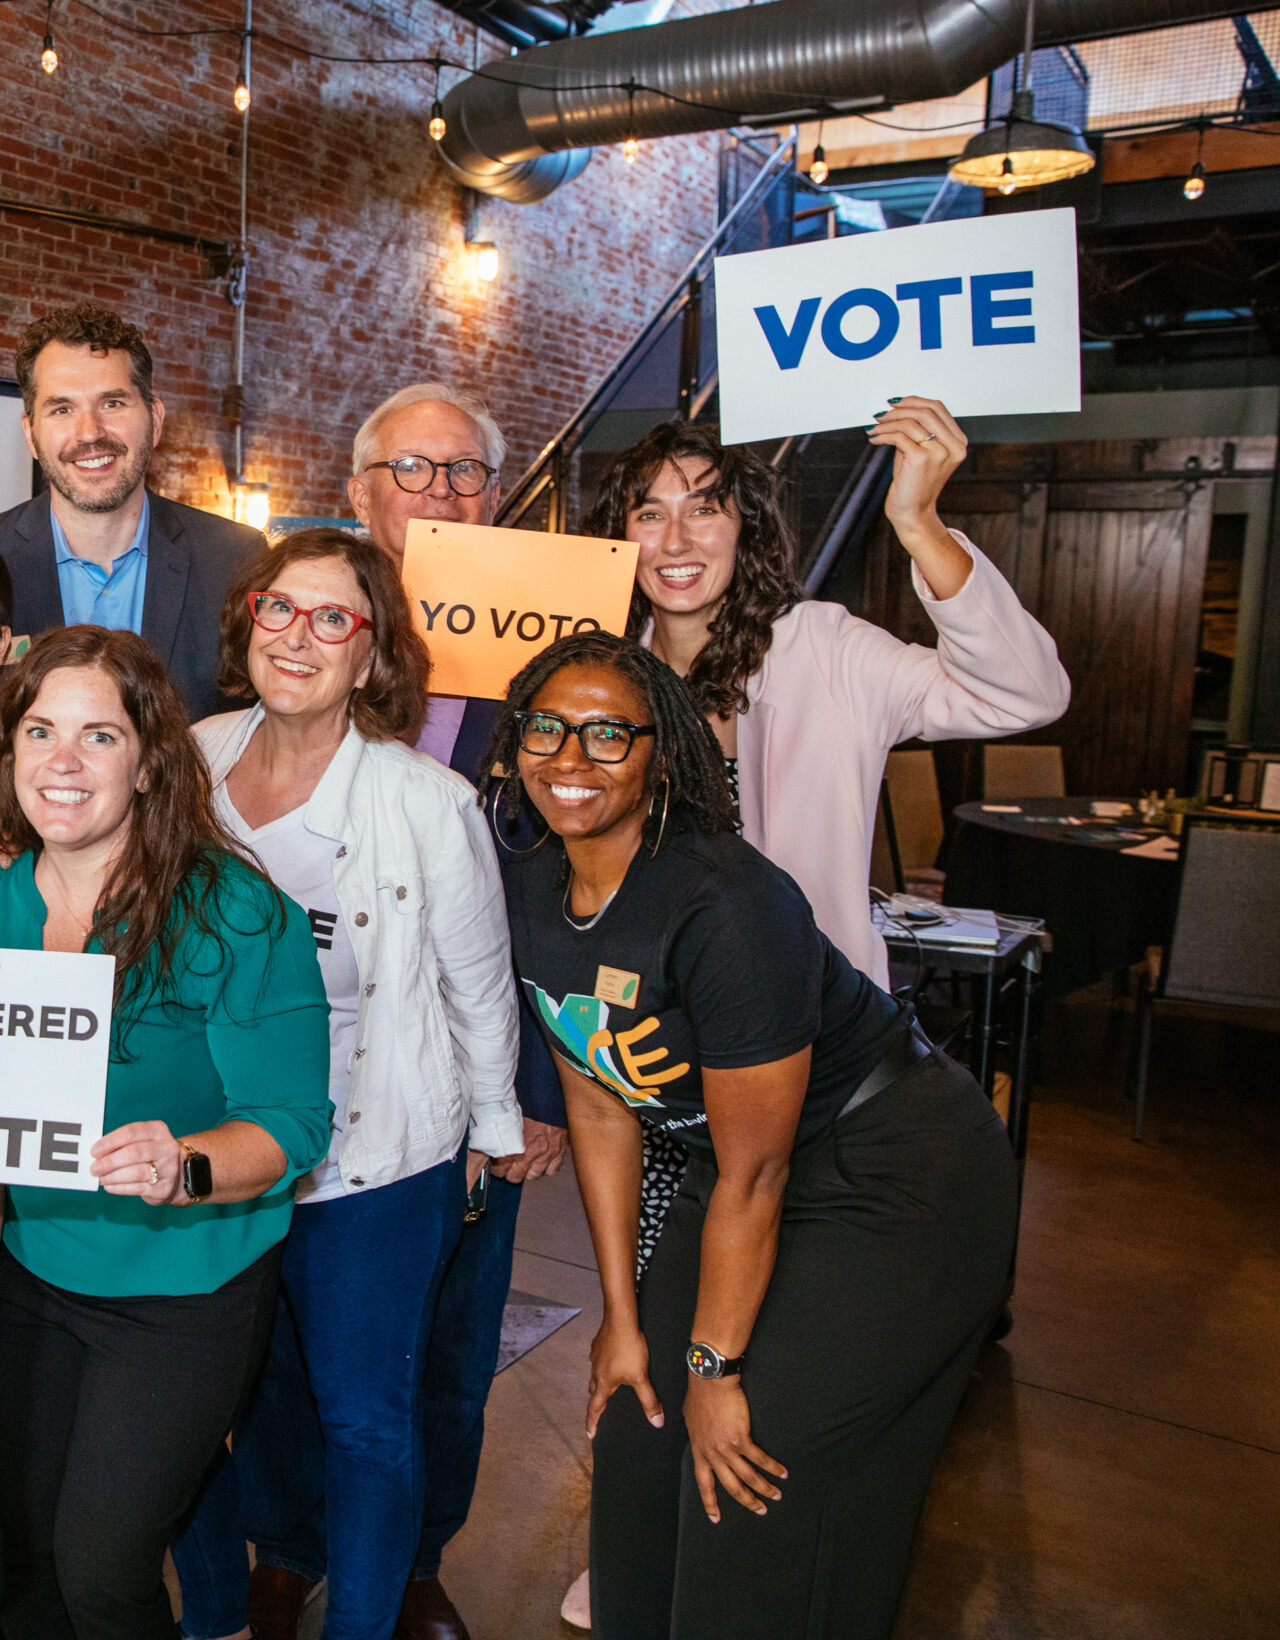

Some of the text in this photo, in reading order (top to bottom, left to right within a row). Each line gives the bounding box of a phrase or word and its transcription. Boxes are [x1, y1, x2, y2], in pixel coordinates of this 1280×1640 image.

[754, 270, 1036, 371] VOTE
[419, 600, 476, 635] YO
[666, 1118, 685, 1130] the
